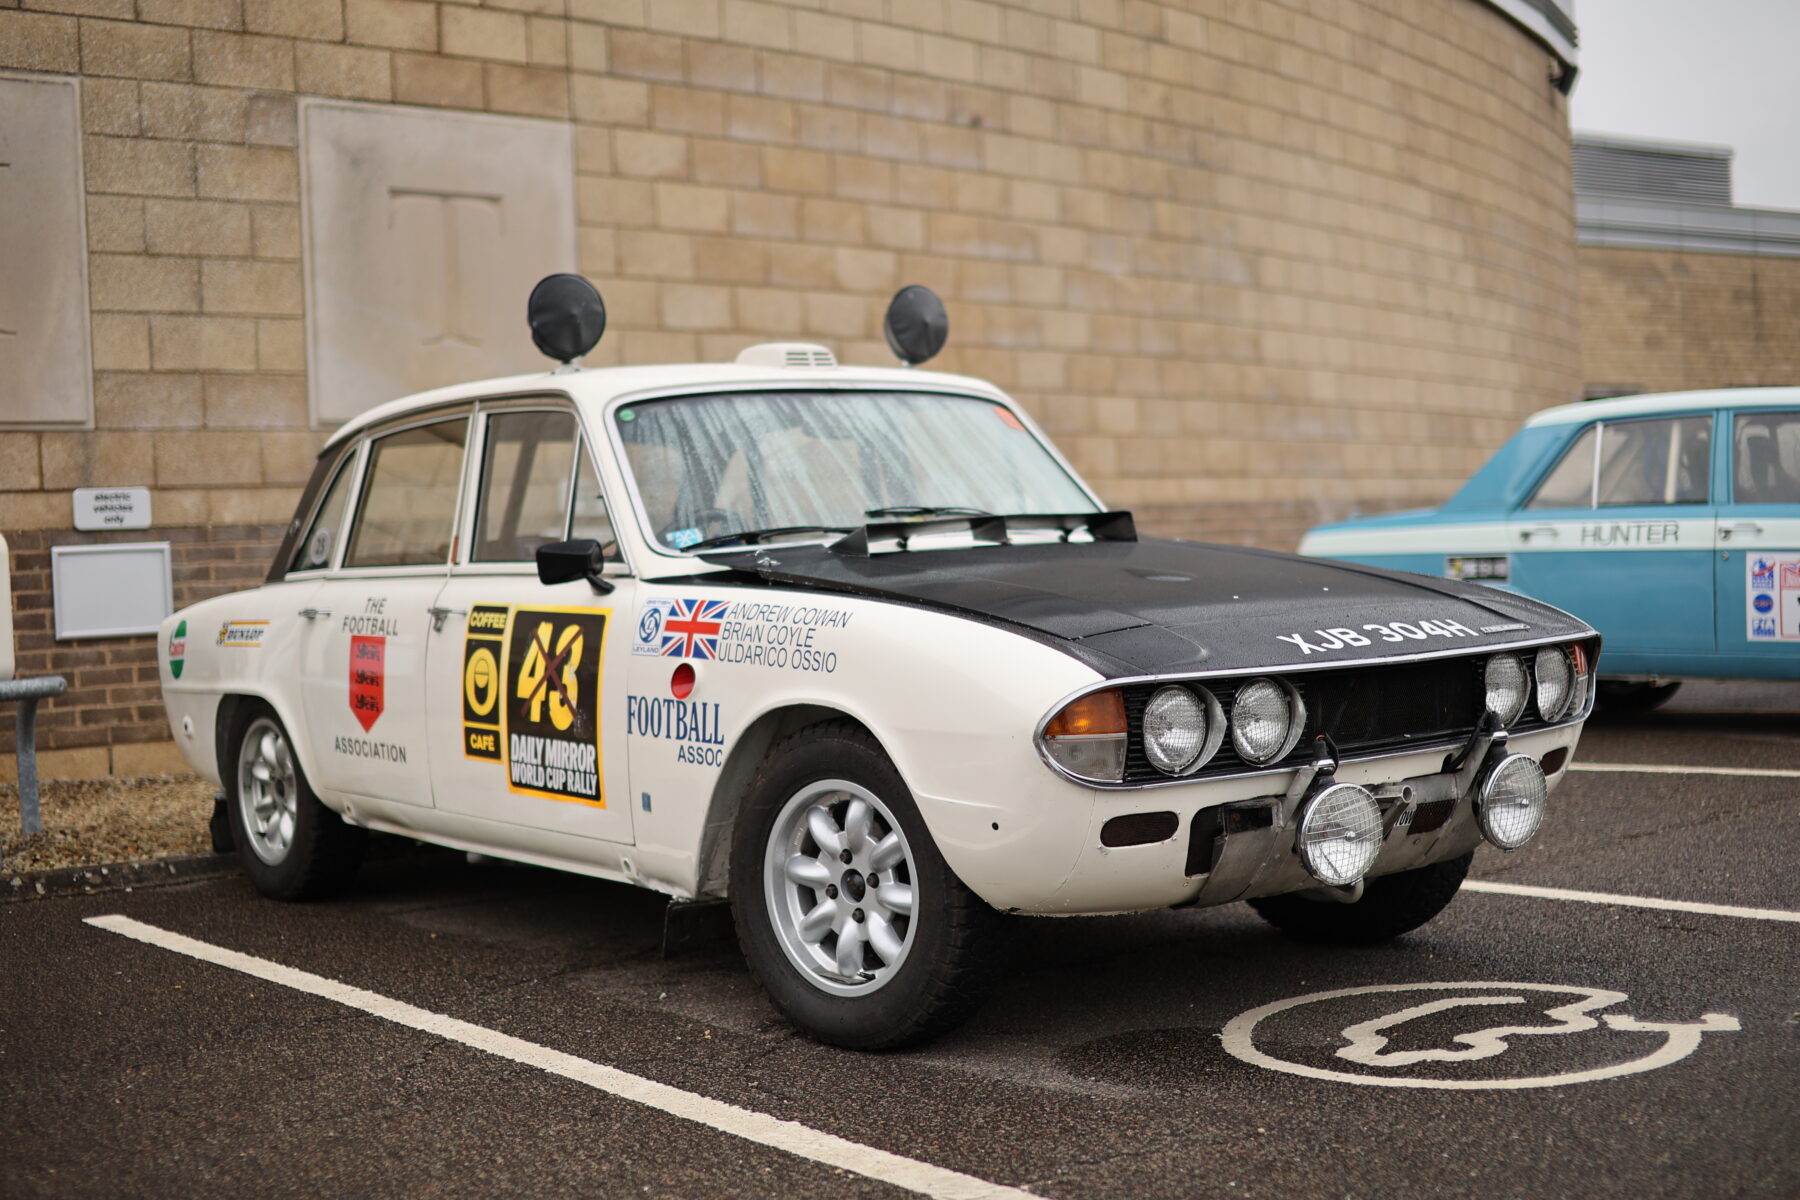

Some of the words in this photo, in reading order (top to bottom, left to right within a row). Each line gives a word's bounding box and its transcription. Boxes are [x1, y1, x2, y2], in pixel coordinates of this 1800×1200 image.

[1581, 520, 1680, 545] HUNTER
[365, 597, 387, 615] THE
[727, 602, 796, 624] ANDREW
[793, 607, 853, 629] COWAN
[342, 616, 399, 636] FOOTBALL
[470, 611, 507, 629] COFFEE
[227, 629, 264, 641] DUNLOP
[722, 621, 764, 643] BRIAN
[767, 624, 816, 648] COYLE
[1276, 627, 1372, 655] XJB
[1362, 618, 1480, 643] 304H
[632, 645, 660, 655] LEYLAND
[718, 642, 787, 668] ULDARICO
[791, 648, 837, 673] OSSIO
[627, 695, 725, 745] FOOTBALL
[334, 736, 407, 764] ASSOCIATION
[510, 732, 545, 767] DAILY
[544, 737, 596, 774] MIRROR
[677, 744, 723, 768] ASSOC
[511, 762, 546, 788] WORLD
[545, 766, 567, 791] CUP
[567, 770, 598, 796] RALLY
